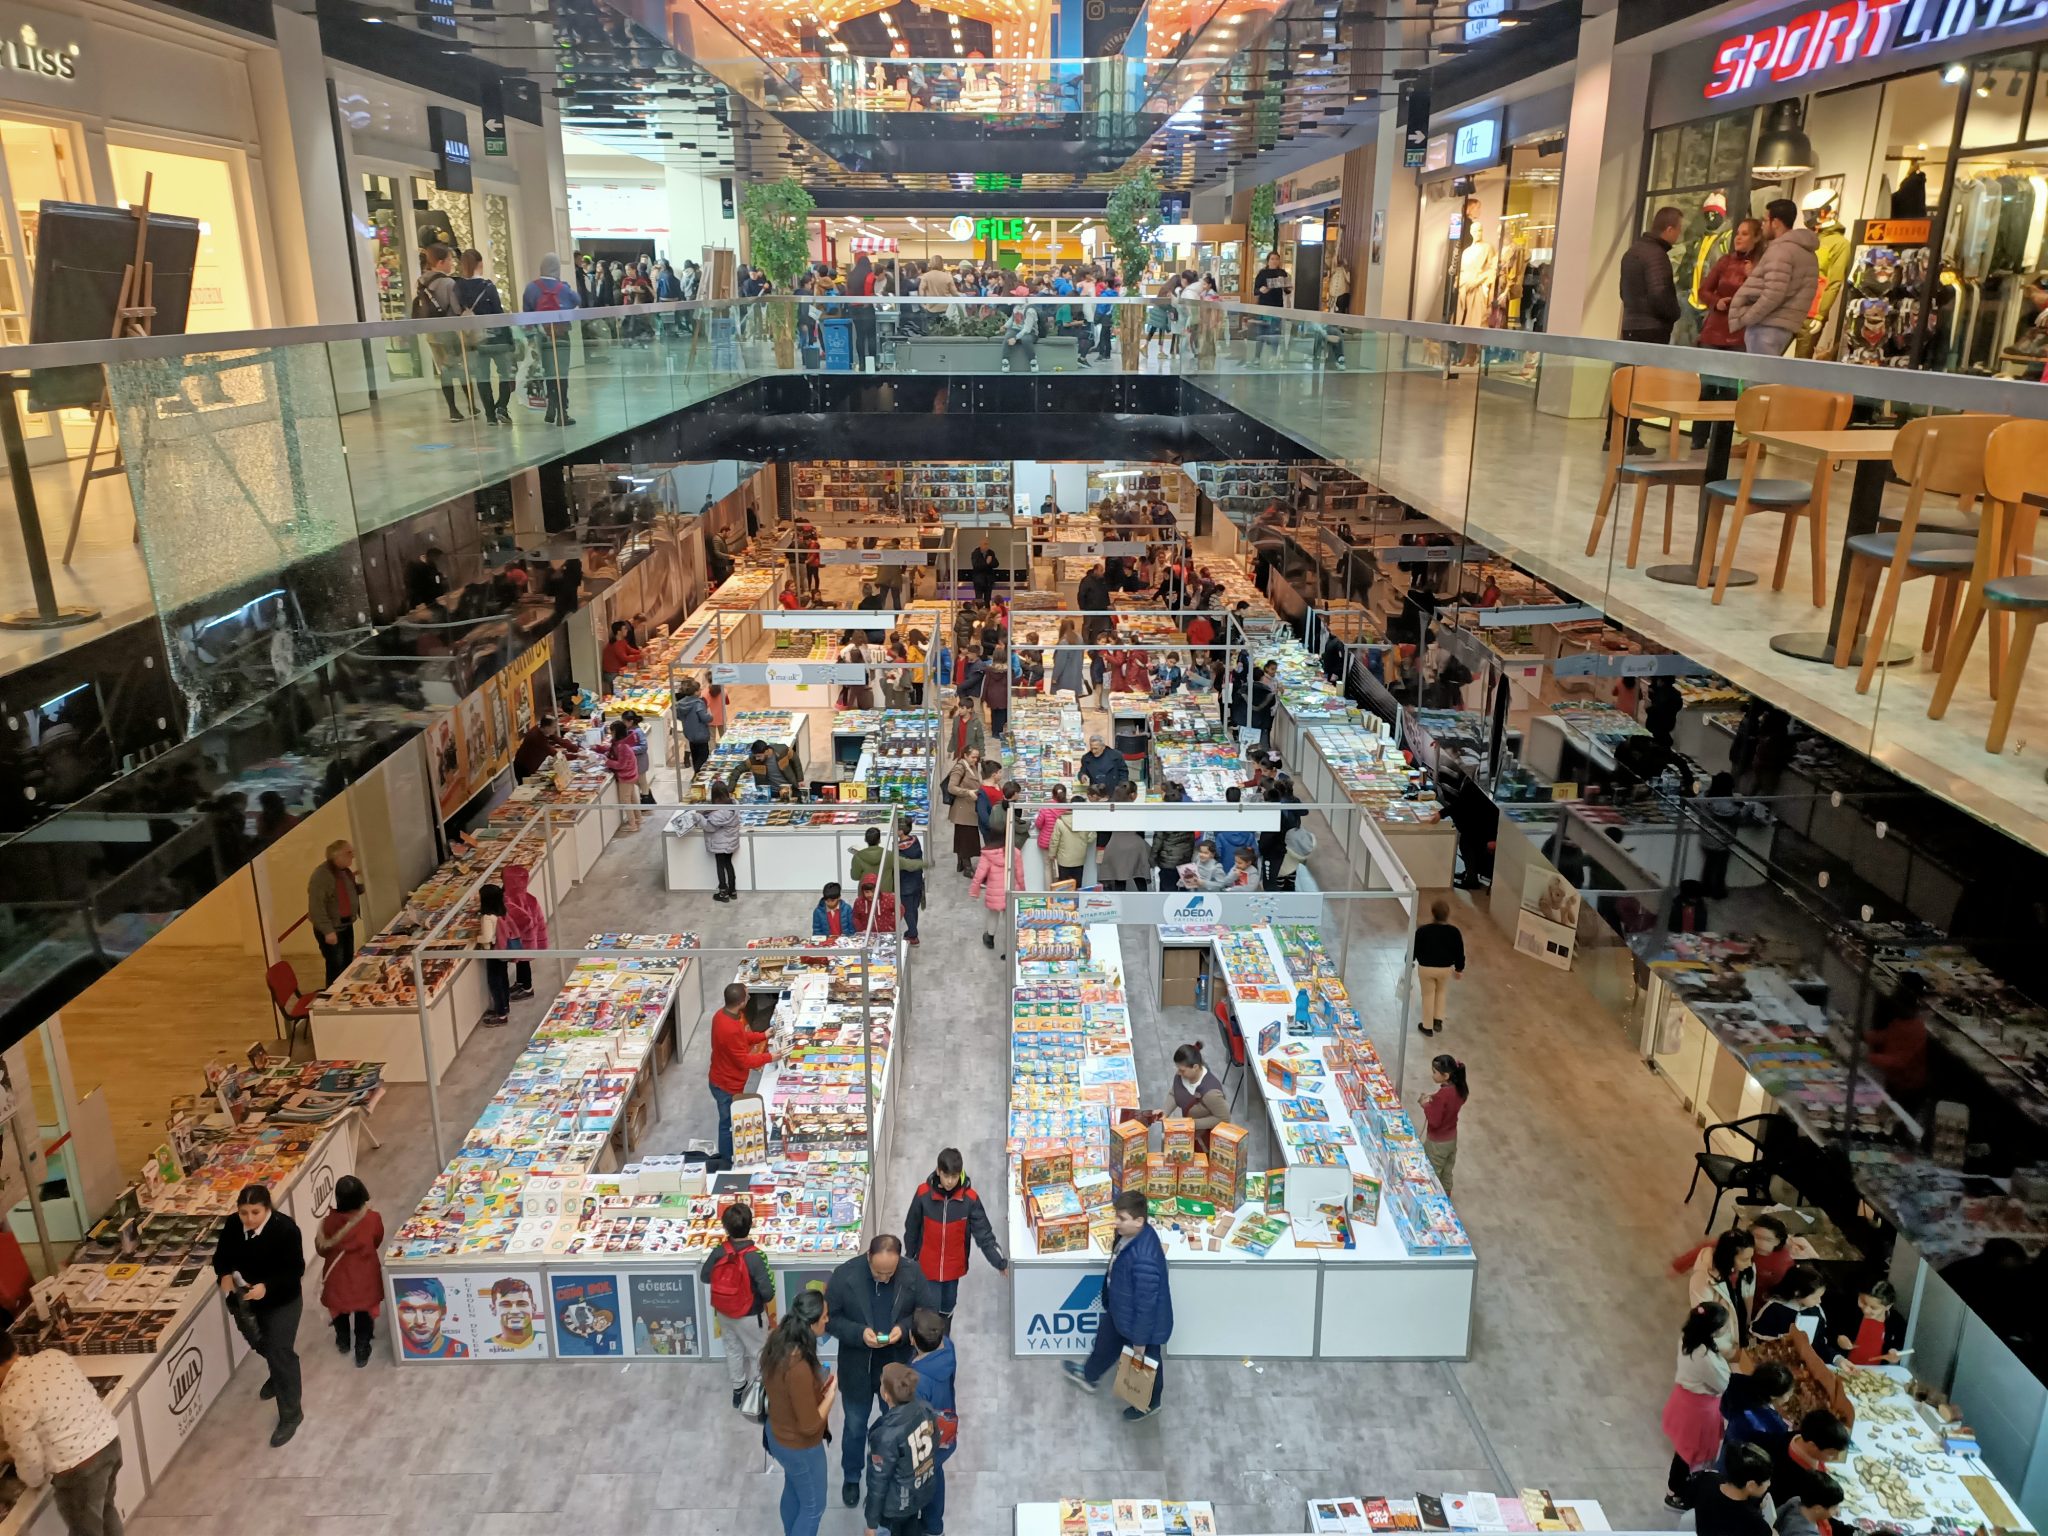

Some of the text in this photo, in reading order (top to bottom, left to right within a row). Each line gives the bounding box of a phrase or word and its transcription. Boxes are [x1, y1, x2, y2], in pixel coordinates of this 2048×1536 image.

[487, 140, 504, 151] EXIT
[847, 788, 858, 798] 10
[1173, 908, 1214, 917] ADEDA
[907, 1419, 935, 1471] 15
